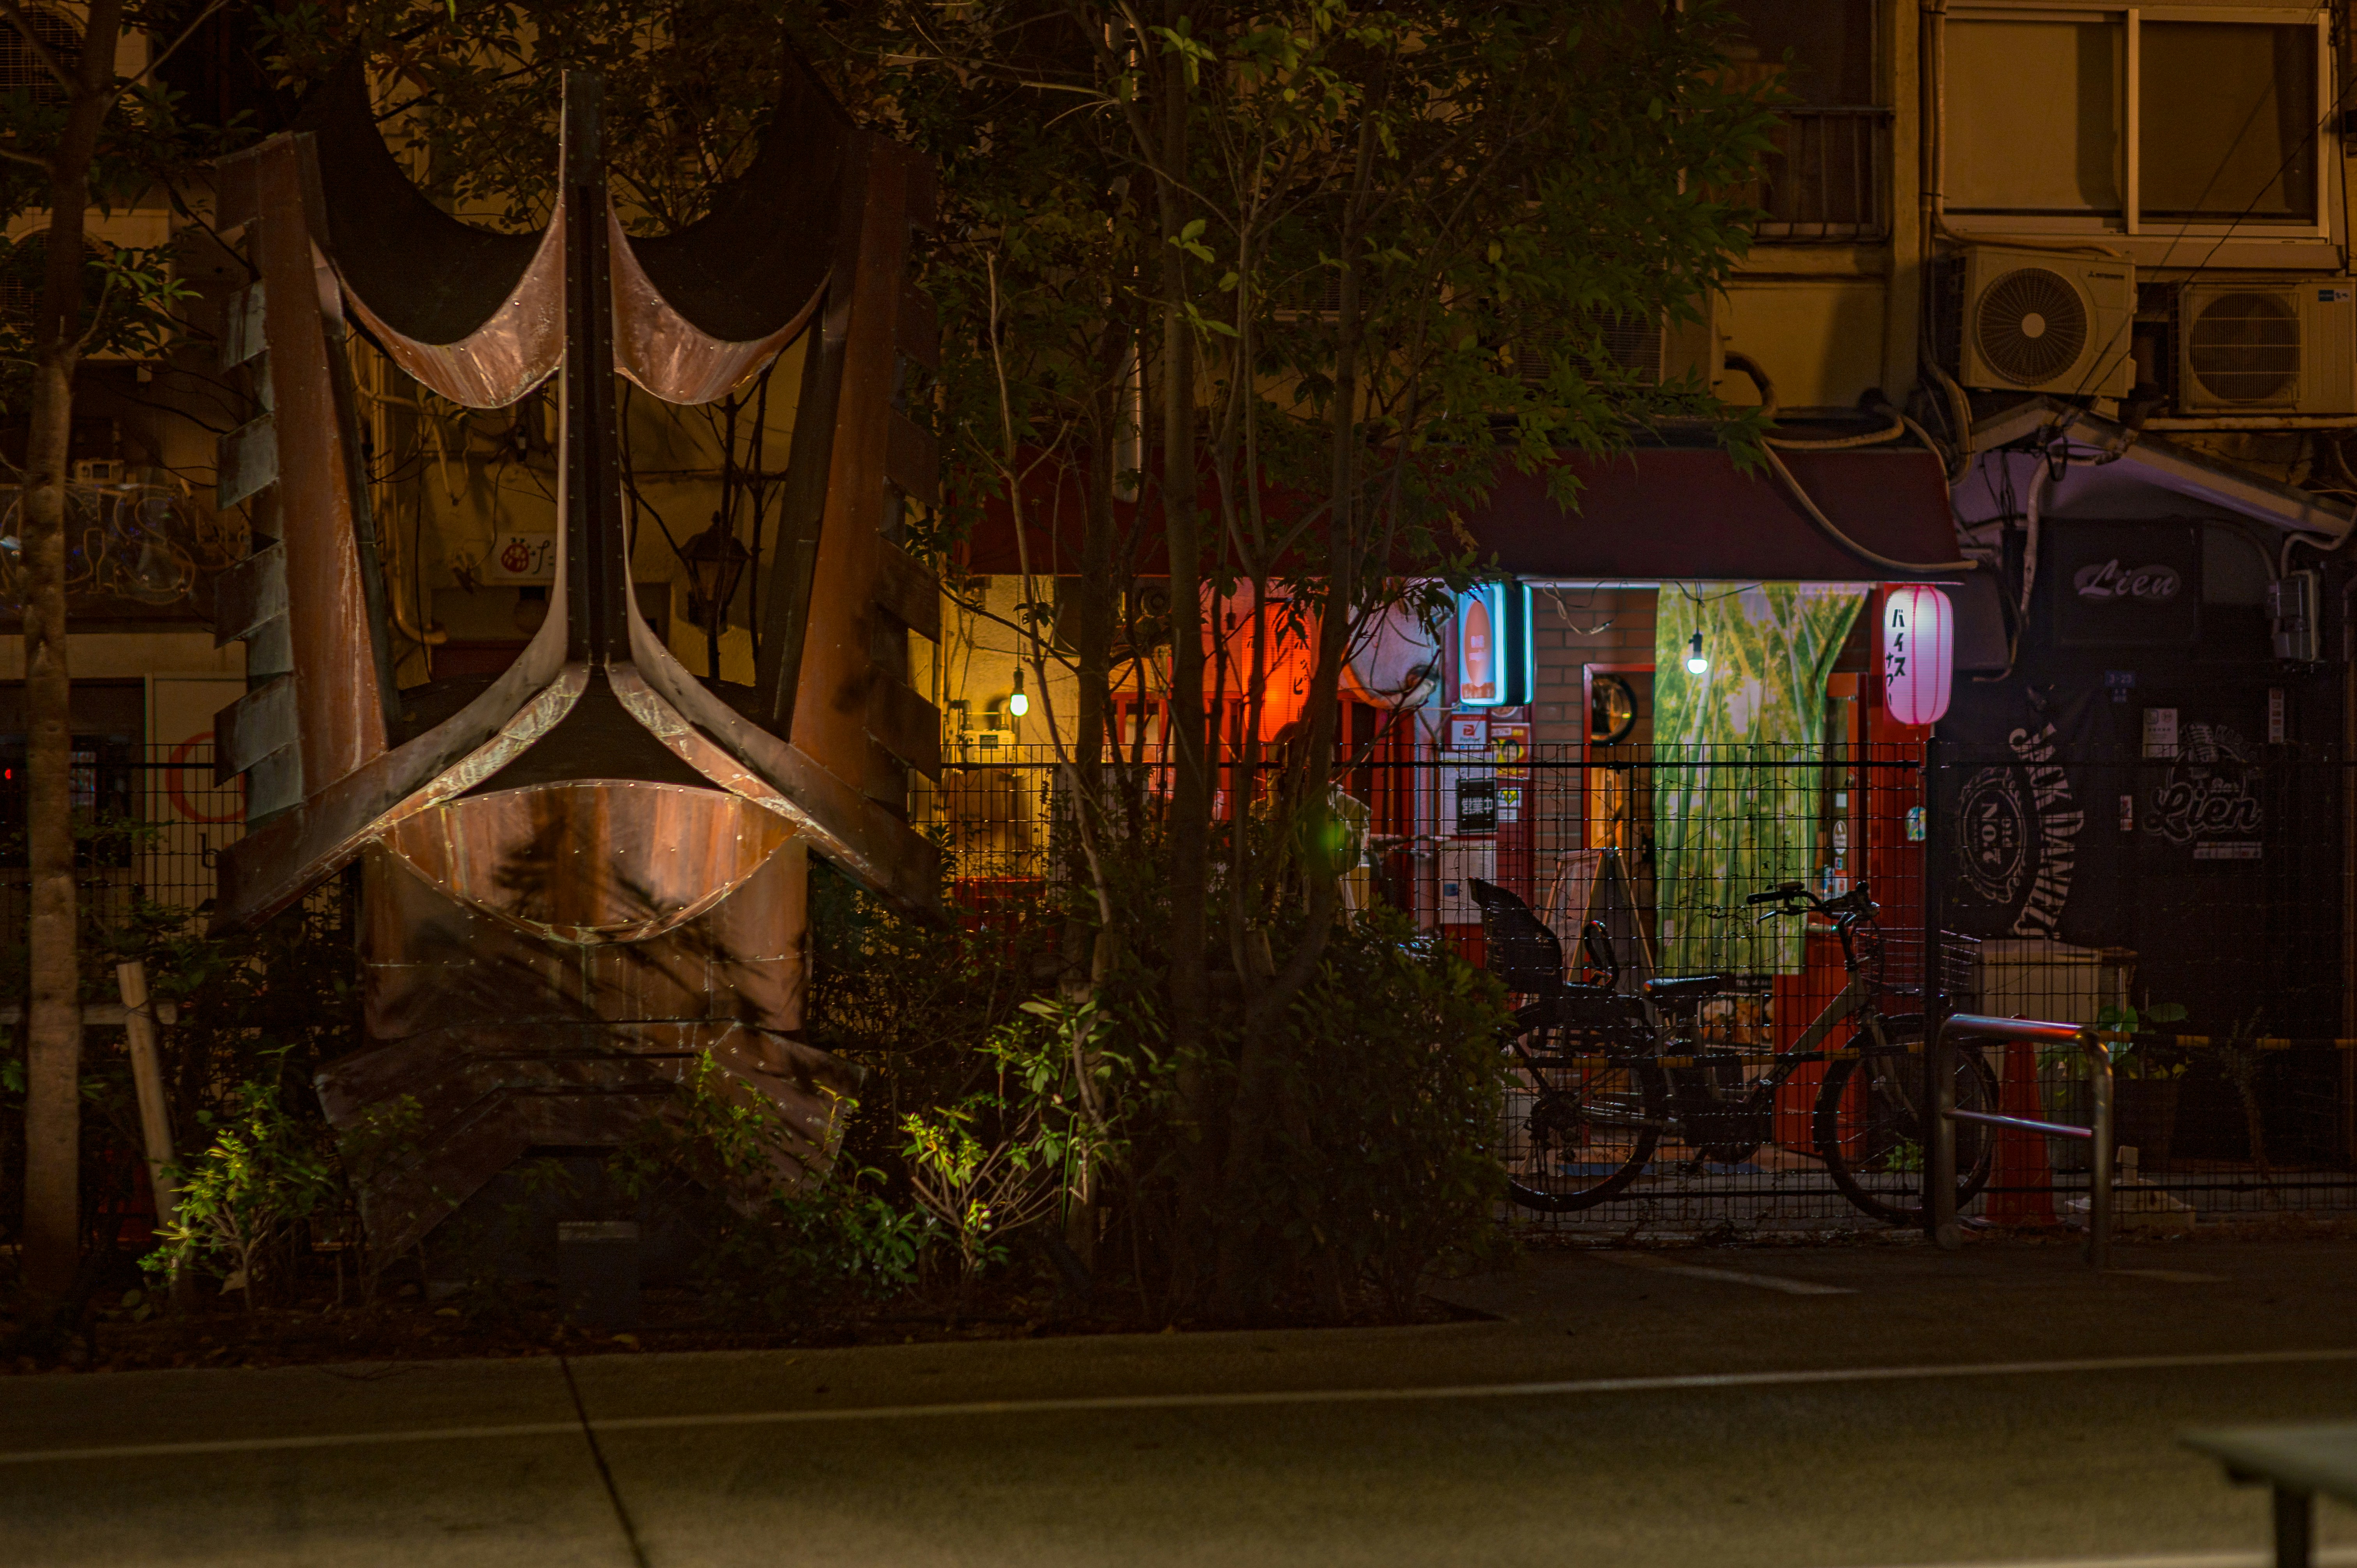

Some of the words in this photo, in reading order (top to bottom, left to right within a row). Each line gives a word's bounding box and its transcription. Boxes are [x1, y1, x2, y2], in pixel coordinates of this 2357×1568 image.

[2078, 558, 2173, 596] Lien
[1892, 609, 1906, 677] バイス
[2009, 722, 2073, 811] JACK
[1461, 796, 1493, 815] 営業中
